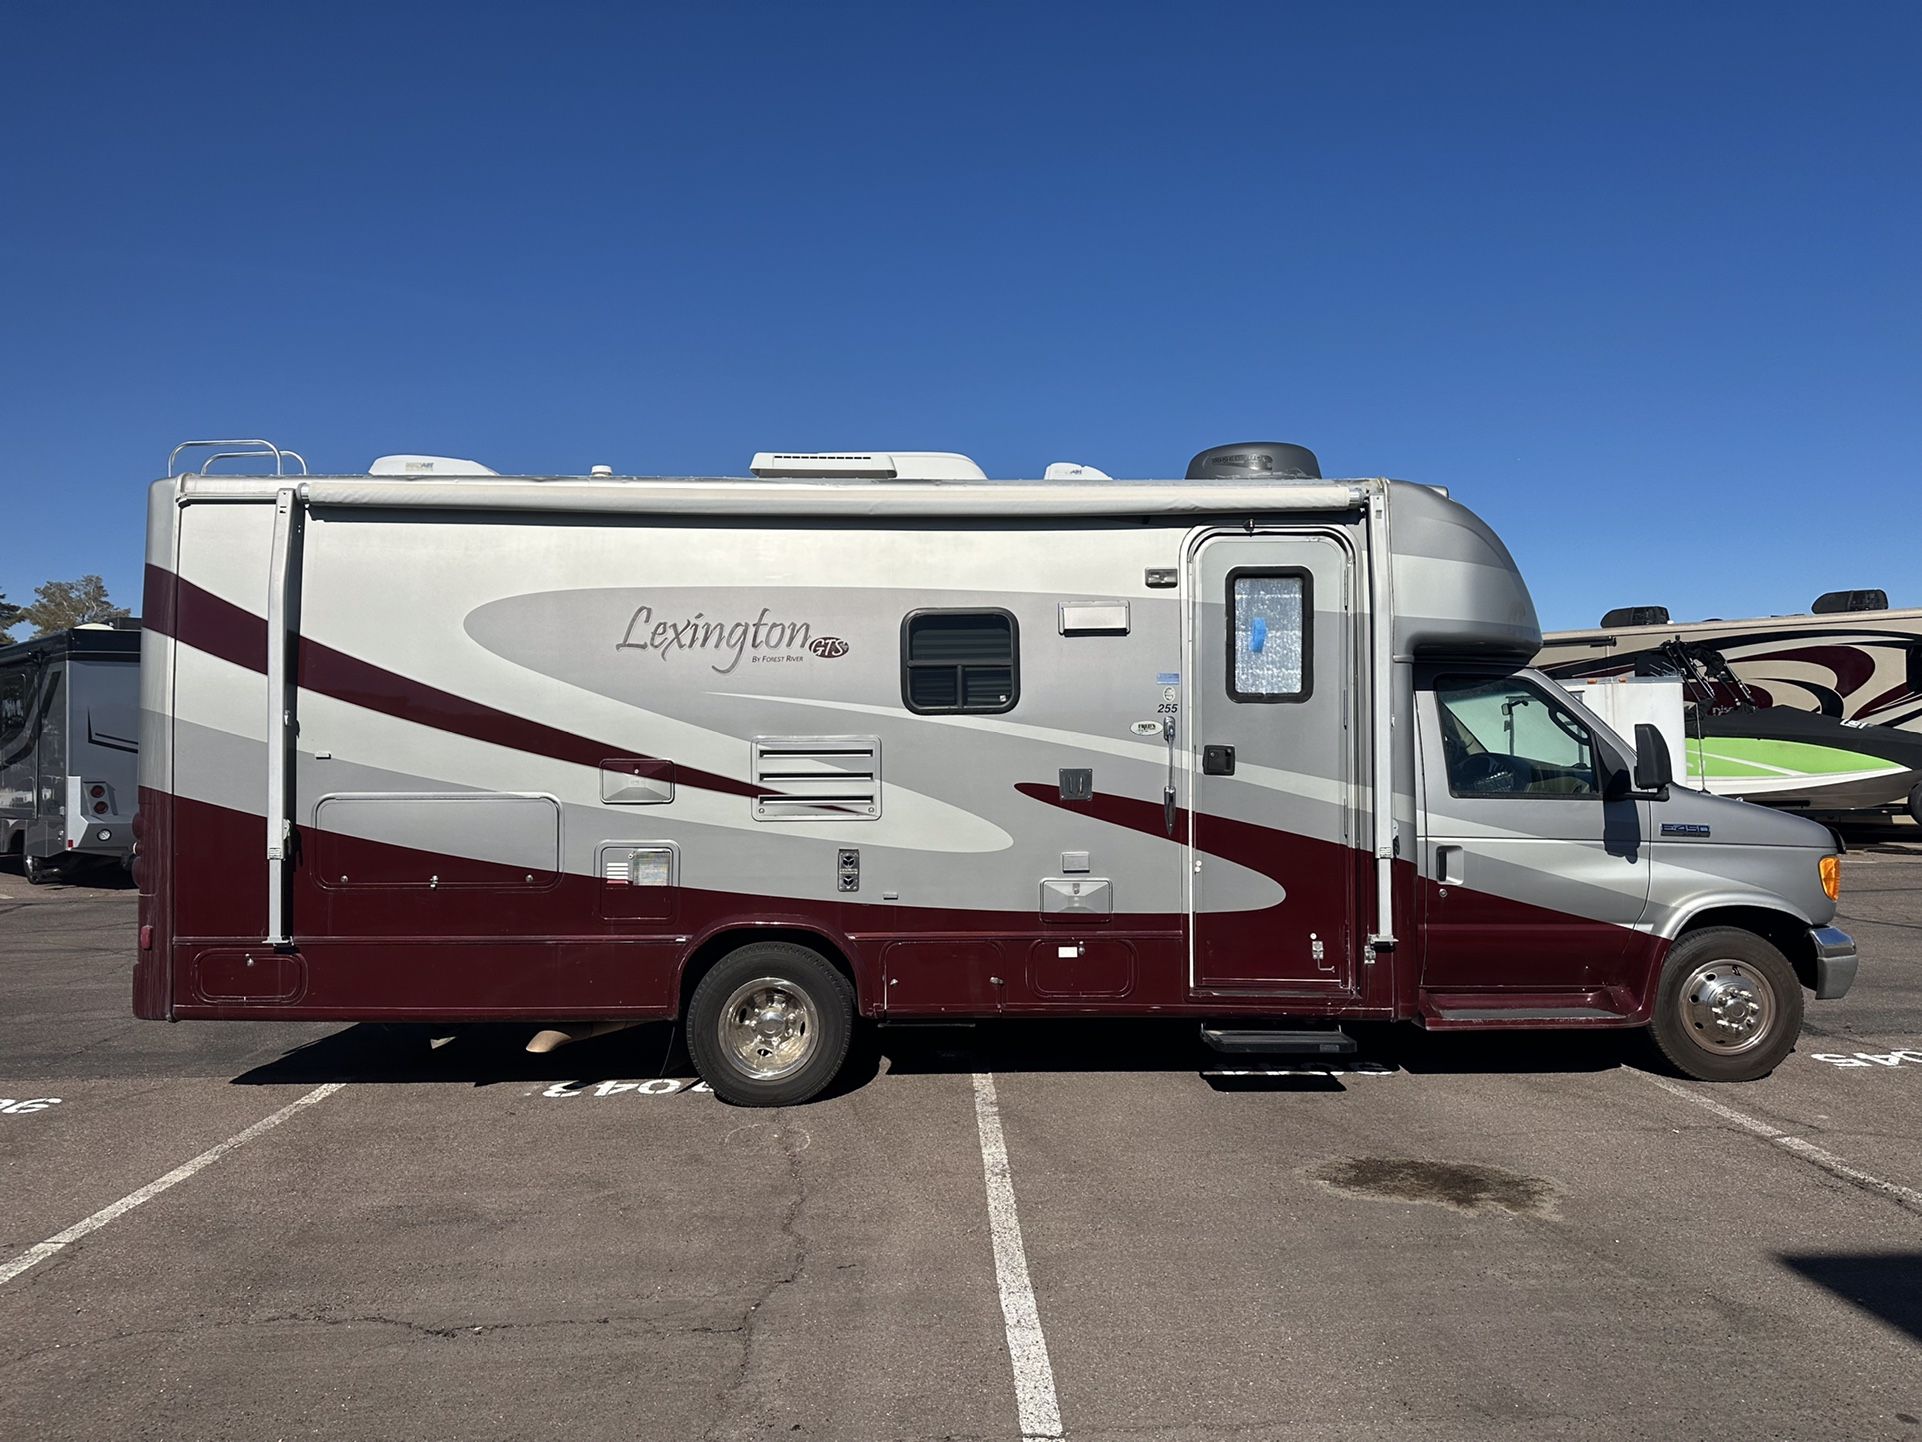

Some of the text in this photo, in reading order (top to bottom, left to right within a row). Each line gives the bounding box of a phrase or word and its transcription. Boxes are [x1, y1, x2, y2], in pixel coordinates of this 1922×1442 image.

[615, 605, 845, 674] Lexington GTS
[1157, 703, 1178, 714] 255
